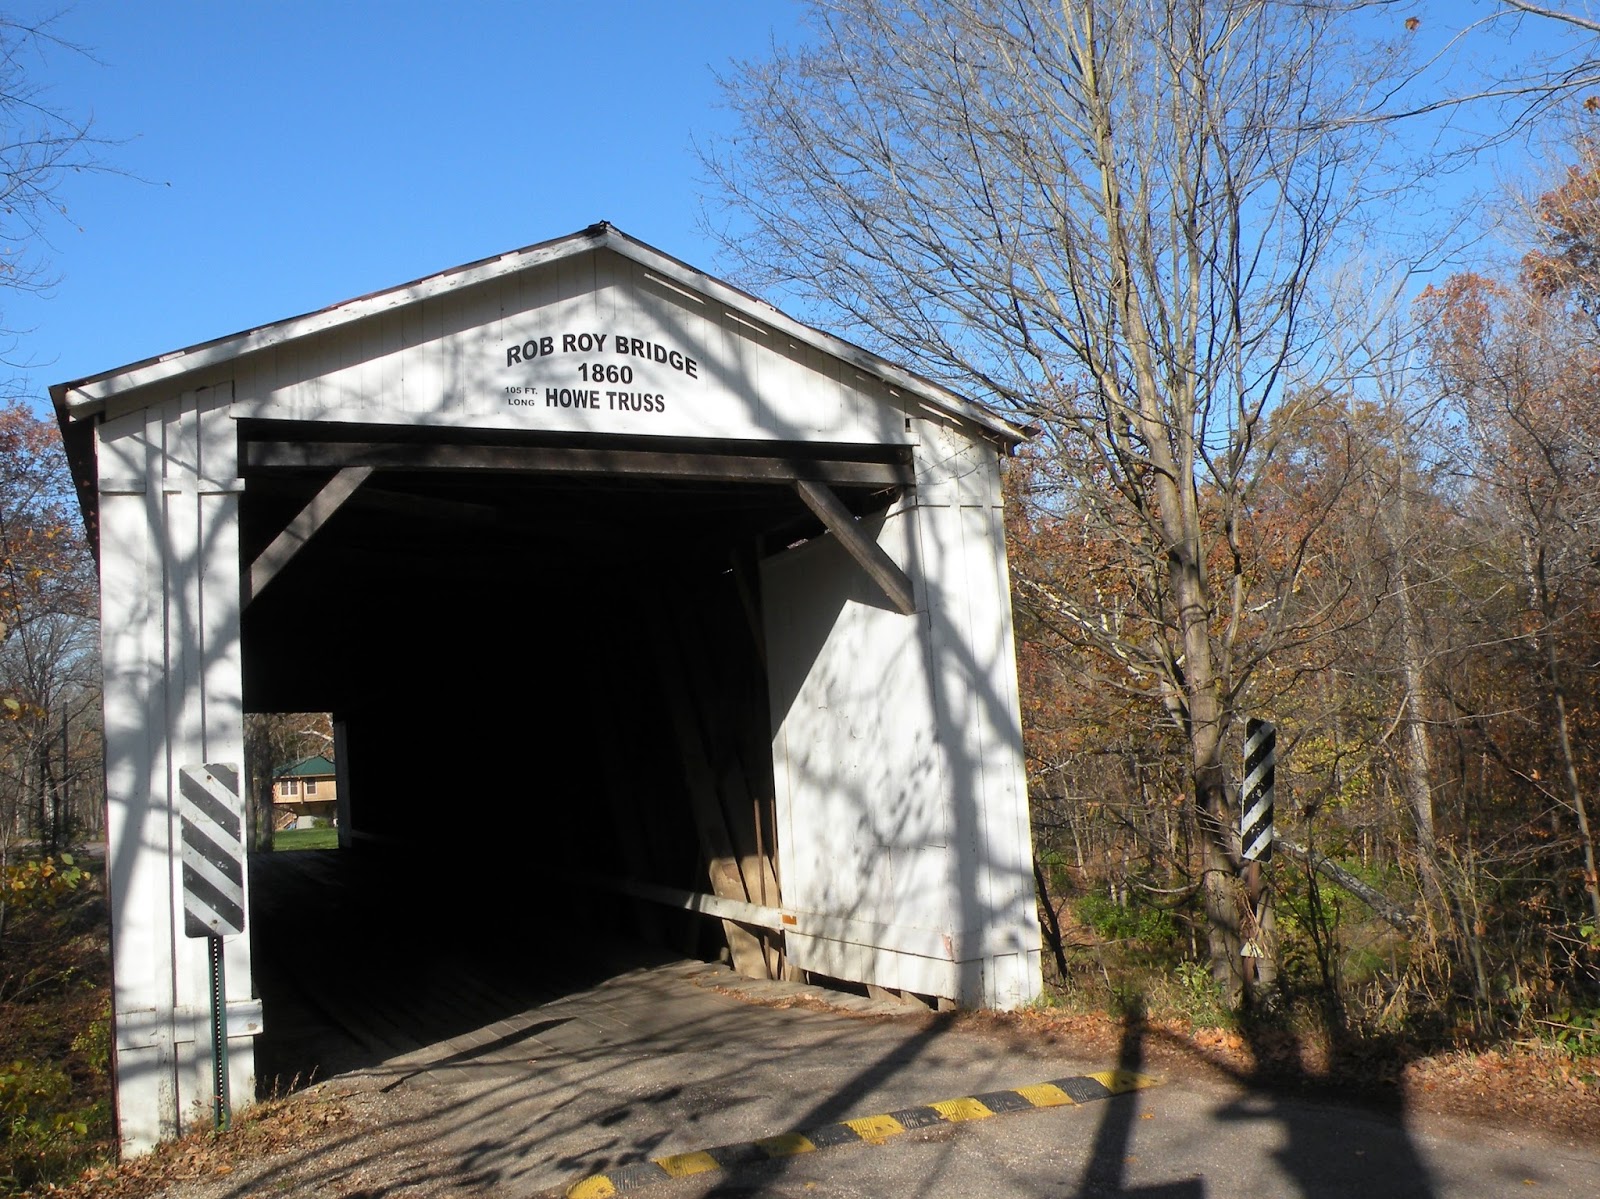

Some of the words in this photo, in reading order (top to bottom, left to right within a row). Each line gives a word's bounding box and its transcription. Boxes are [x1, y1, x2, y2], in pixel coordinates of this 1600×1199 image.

[506, 336, 554, 367] ROB
[562, 333, 607, 353] ROY
[615, 335, 698, 380] BRIDGE
[577, 363, 633, 384] 1860
[524, 387, 538, 395] FT.
[546, 388, 600, 410] HOWE
[606, 391, 665, 413] TRUSS
